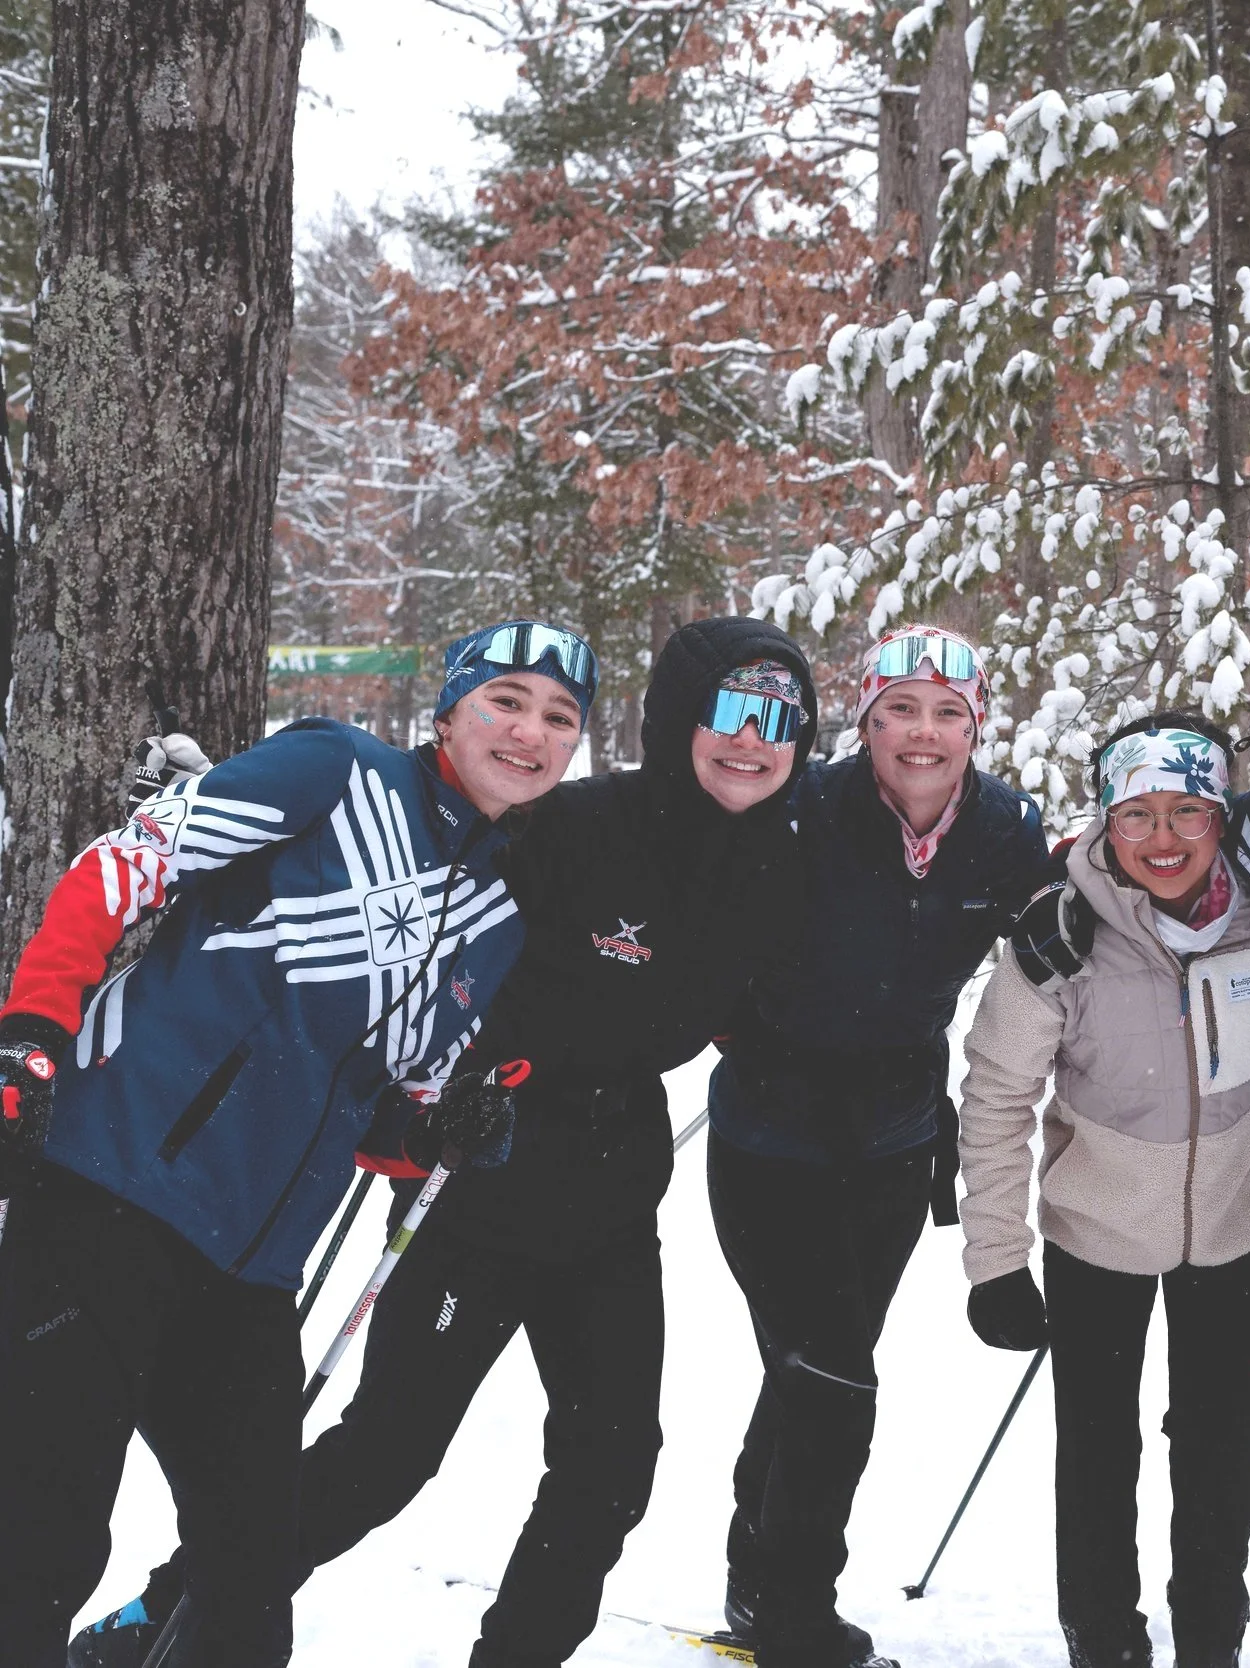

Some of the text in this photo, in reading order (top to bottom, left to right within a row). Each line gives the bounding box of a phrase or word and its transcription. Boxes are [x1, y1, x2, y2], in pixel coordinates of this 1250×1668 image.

[592, 933, 651, 961] VASA
[26, 1313, 67, 1341] CRAFT
[344, 1290, 377, 1337] ROSSIGNOL
